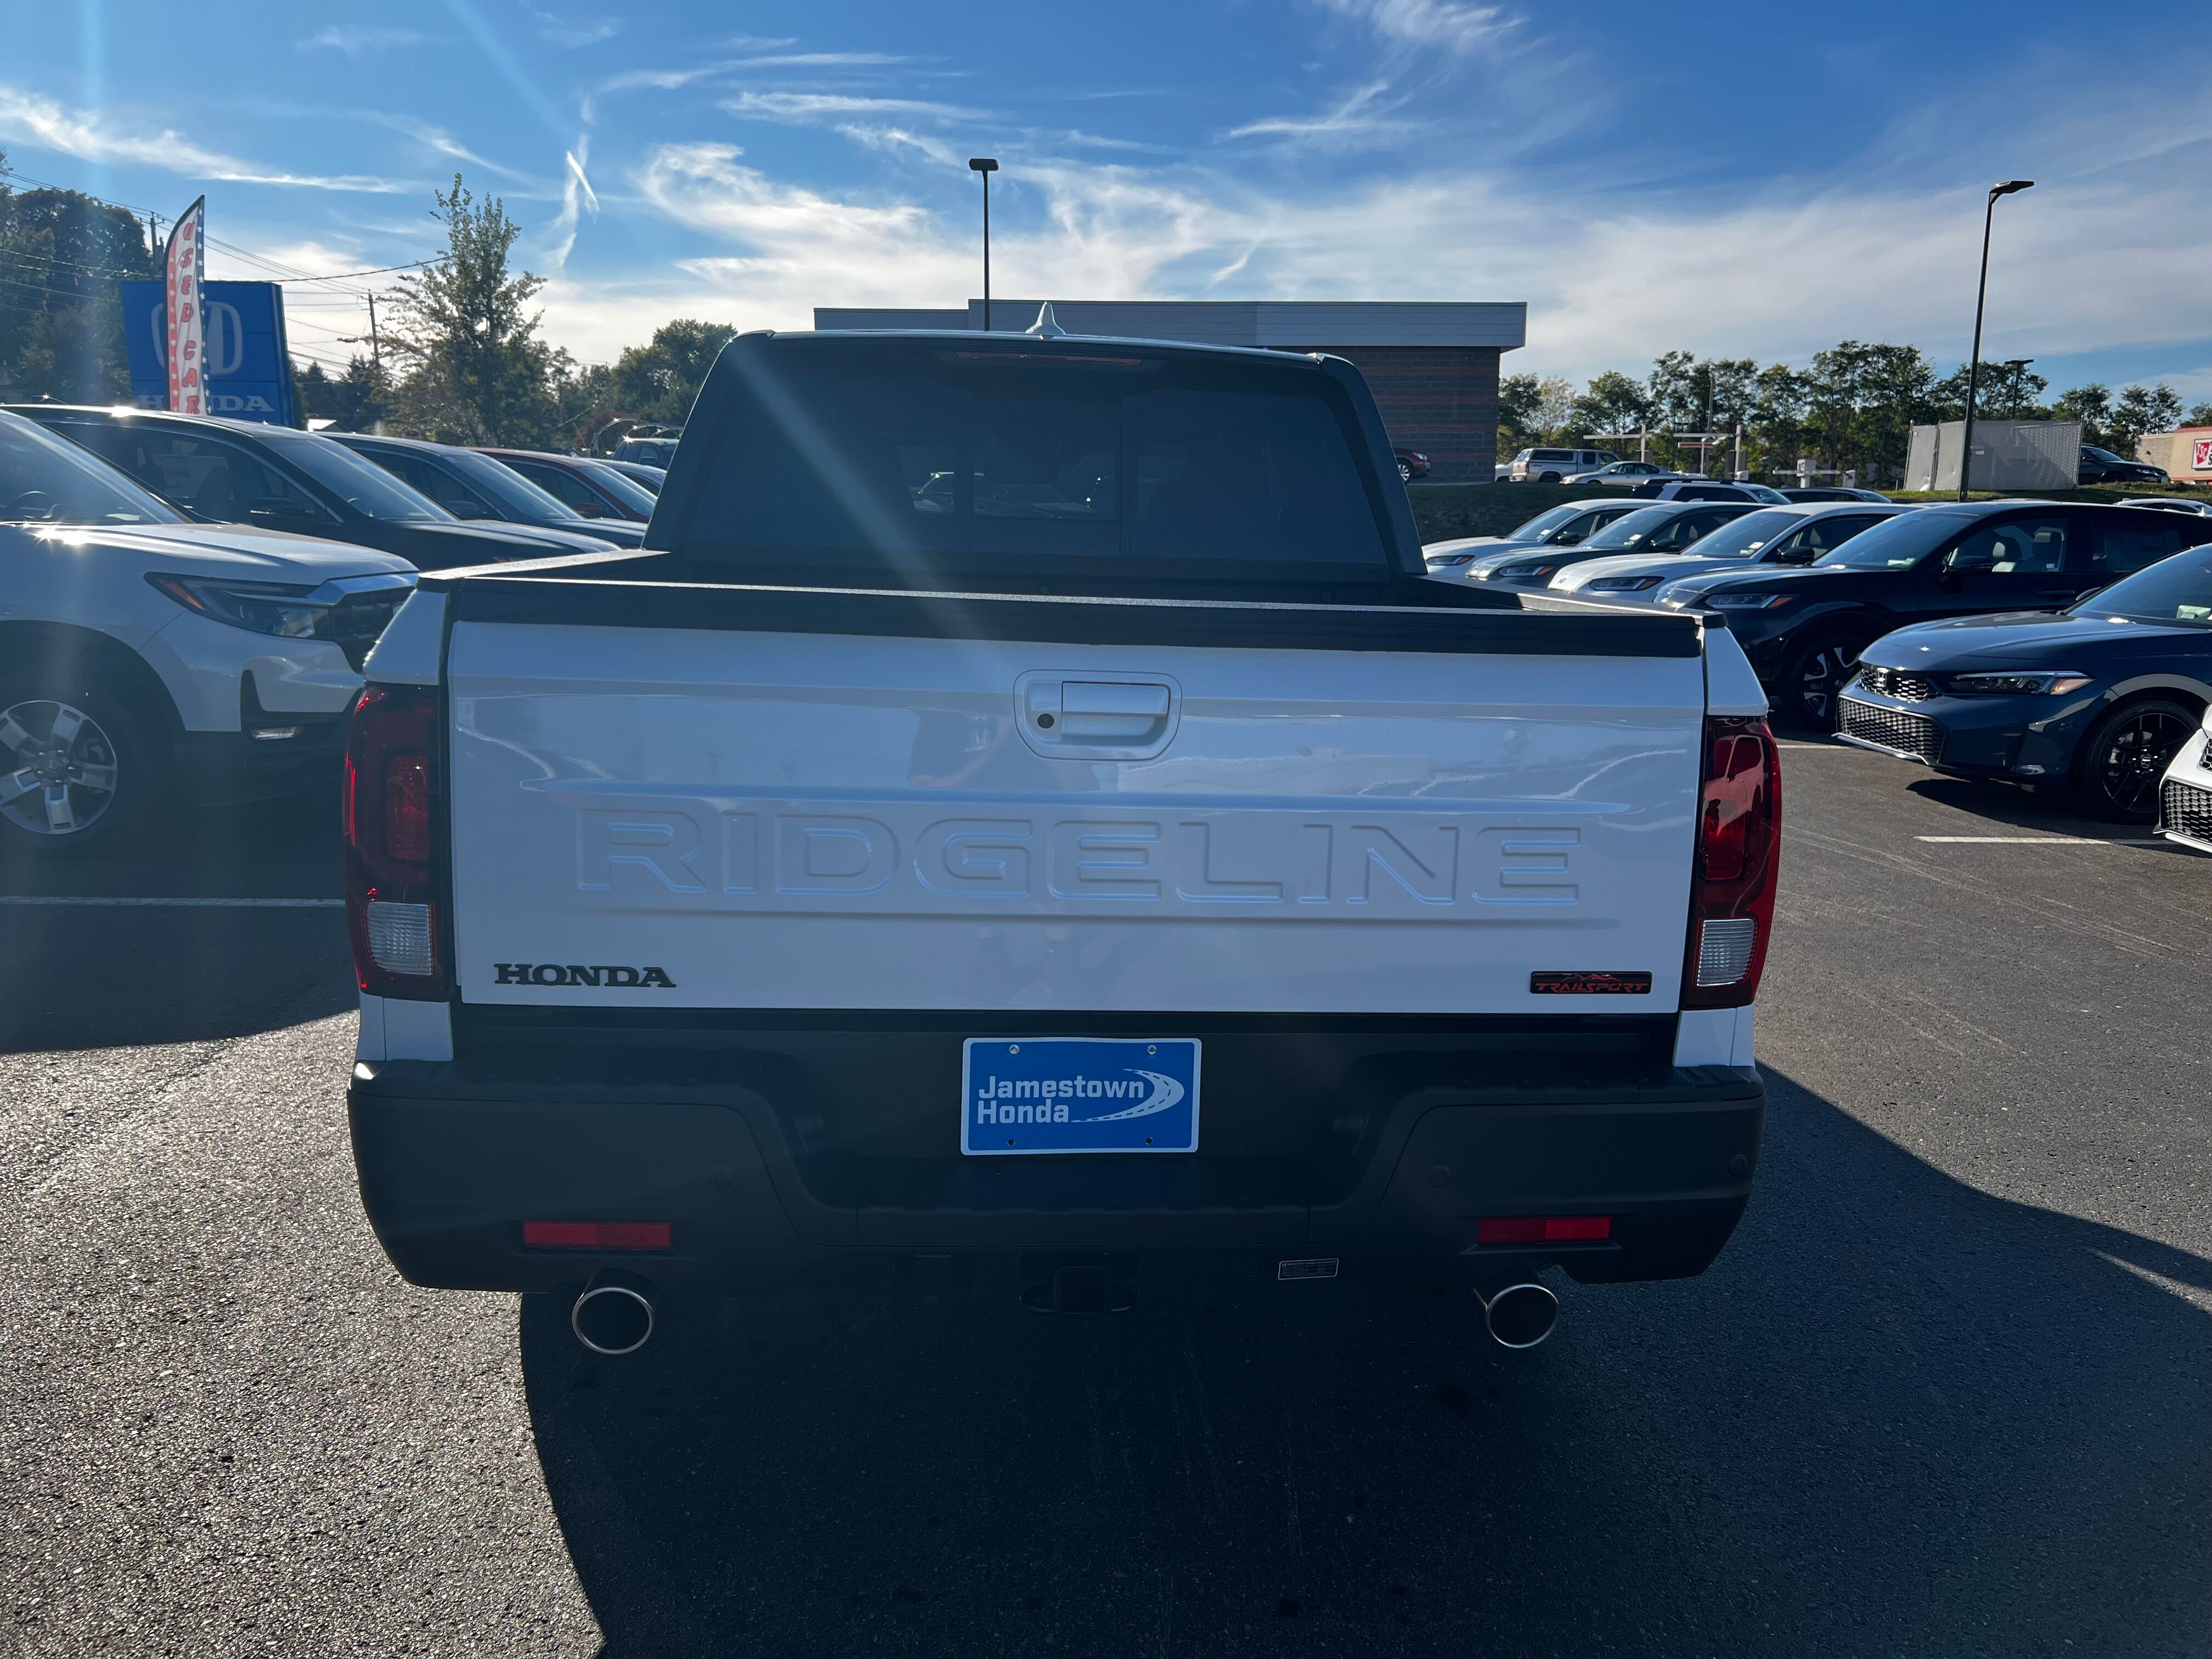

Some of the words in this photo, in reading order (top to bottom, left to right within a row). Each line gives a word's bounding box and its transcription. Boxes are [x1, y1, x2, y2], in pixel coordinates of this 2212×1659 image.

[180, 222, 195, 323] USED
[139, 395, 274, 411] HDA
[2197, 443, 2207, 460] TSC
[577, 808, 1582, 905] RIDGELINE
[494, 963, 676, 988] HONDA
[1535, 982, 1648, 993] TRAILSPORT
[978, 1075, 1144, 1099] Jamestown
[977, 1098, 1069, 1124] Honda
